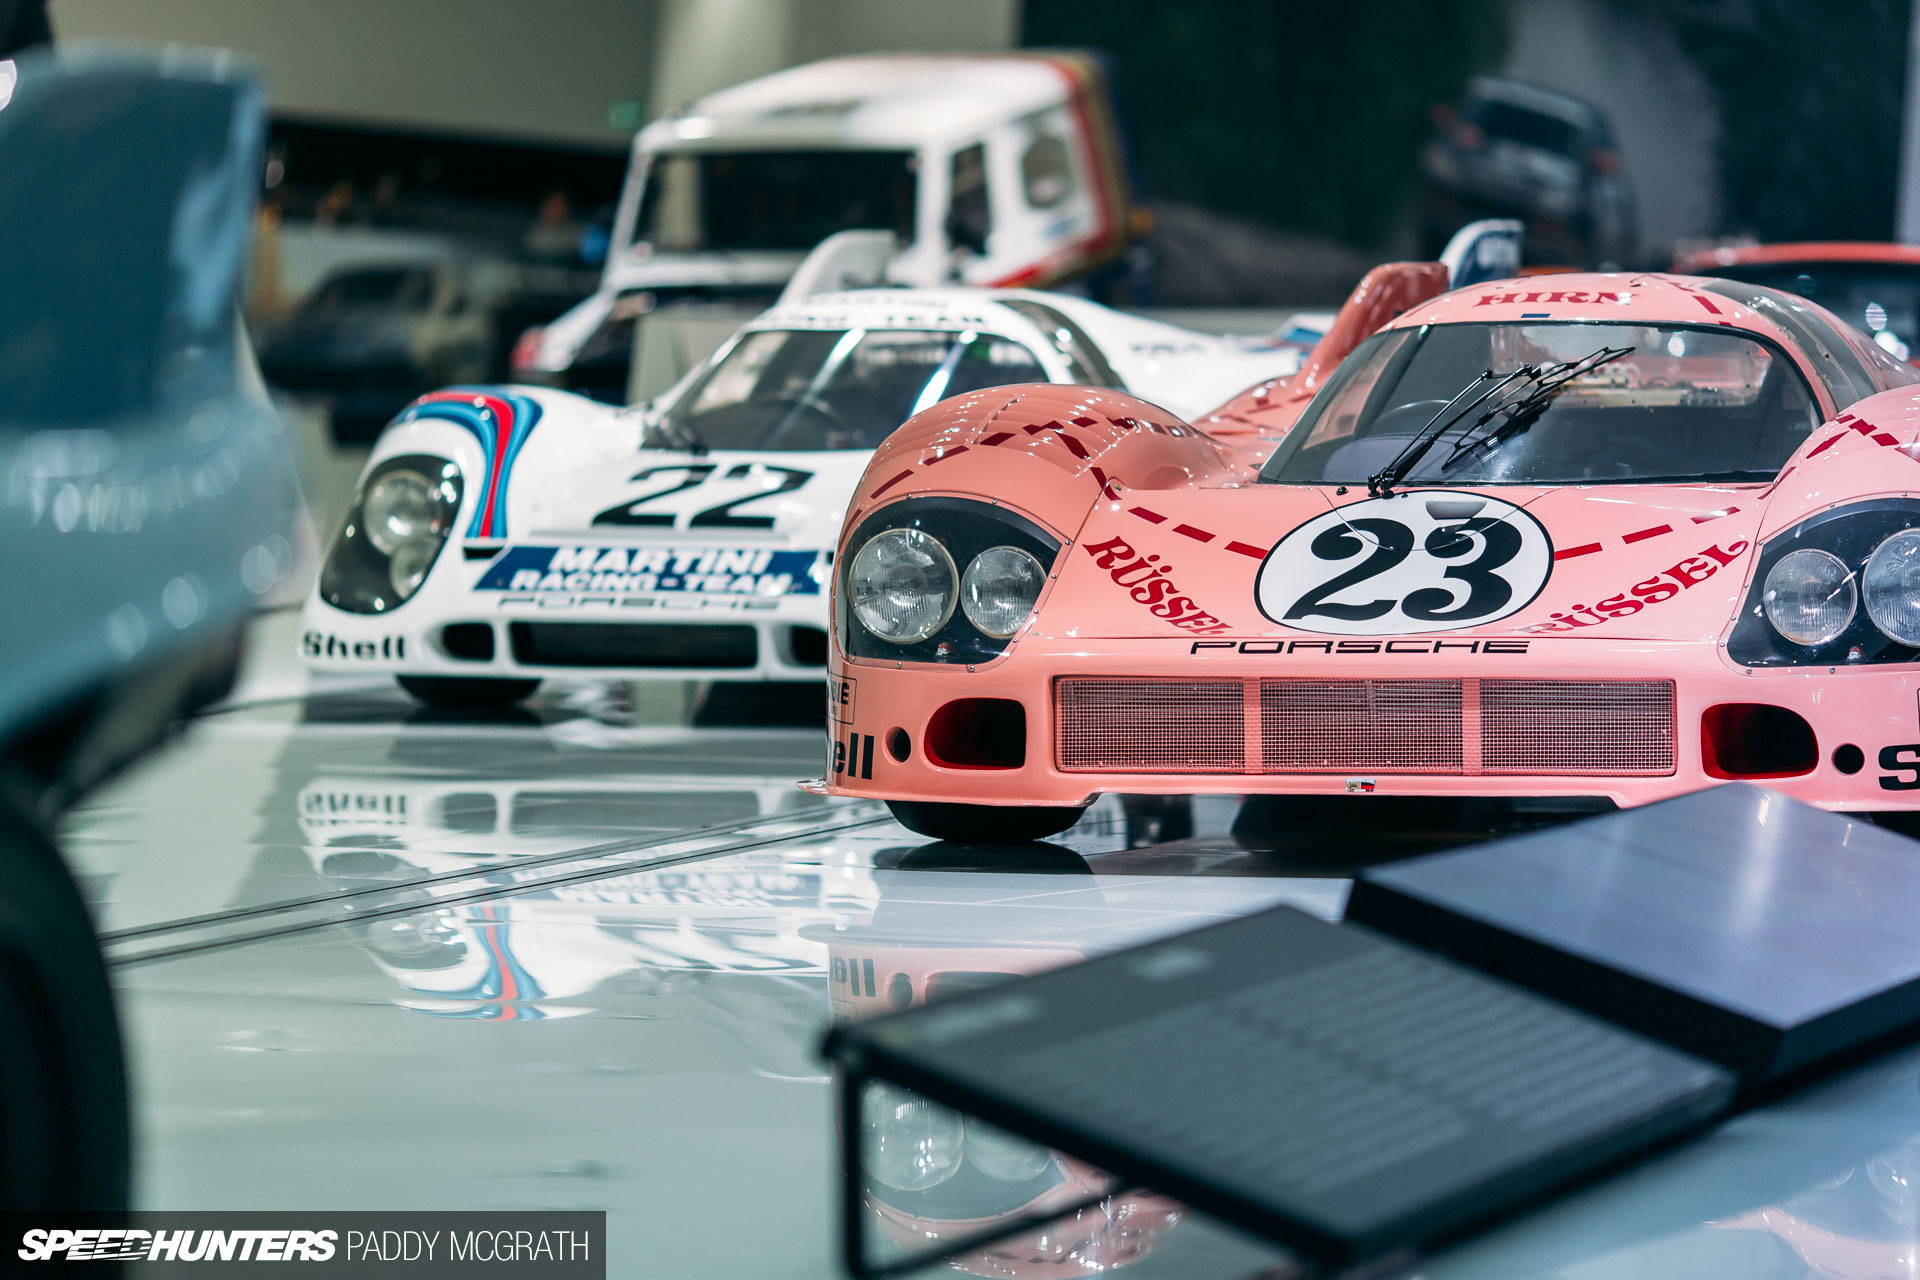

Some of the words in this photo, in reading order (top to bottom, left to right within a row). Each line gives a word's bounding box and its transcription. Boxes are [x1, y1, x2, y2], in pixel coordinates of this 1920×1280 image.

[1473, 291, 1639, 308] HIRN
[591, 463, 815, 529] 22
[548, 547, 774, 573] MARTINI
[1281, 516, 1523, 622] 23
[1082, 535, 1235, 636] RÜSSEL
[1511, 539, 1749, 635] RÜSSEL
[303, 630, 406, 659] Shell
[1189, 640, 1531, 655] PORSCHE
